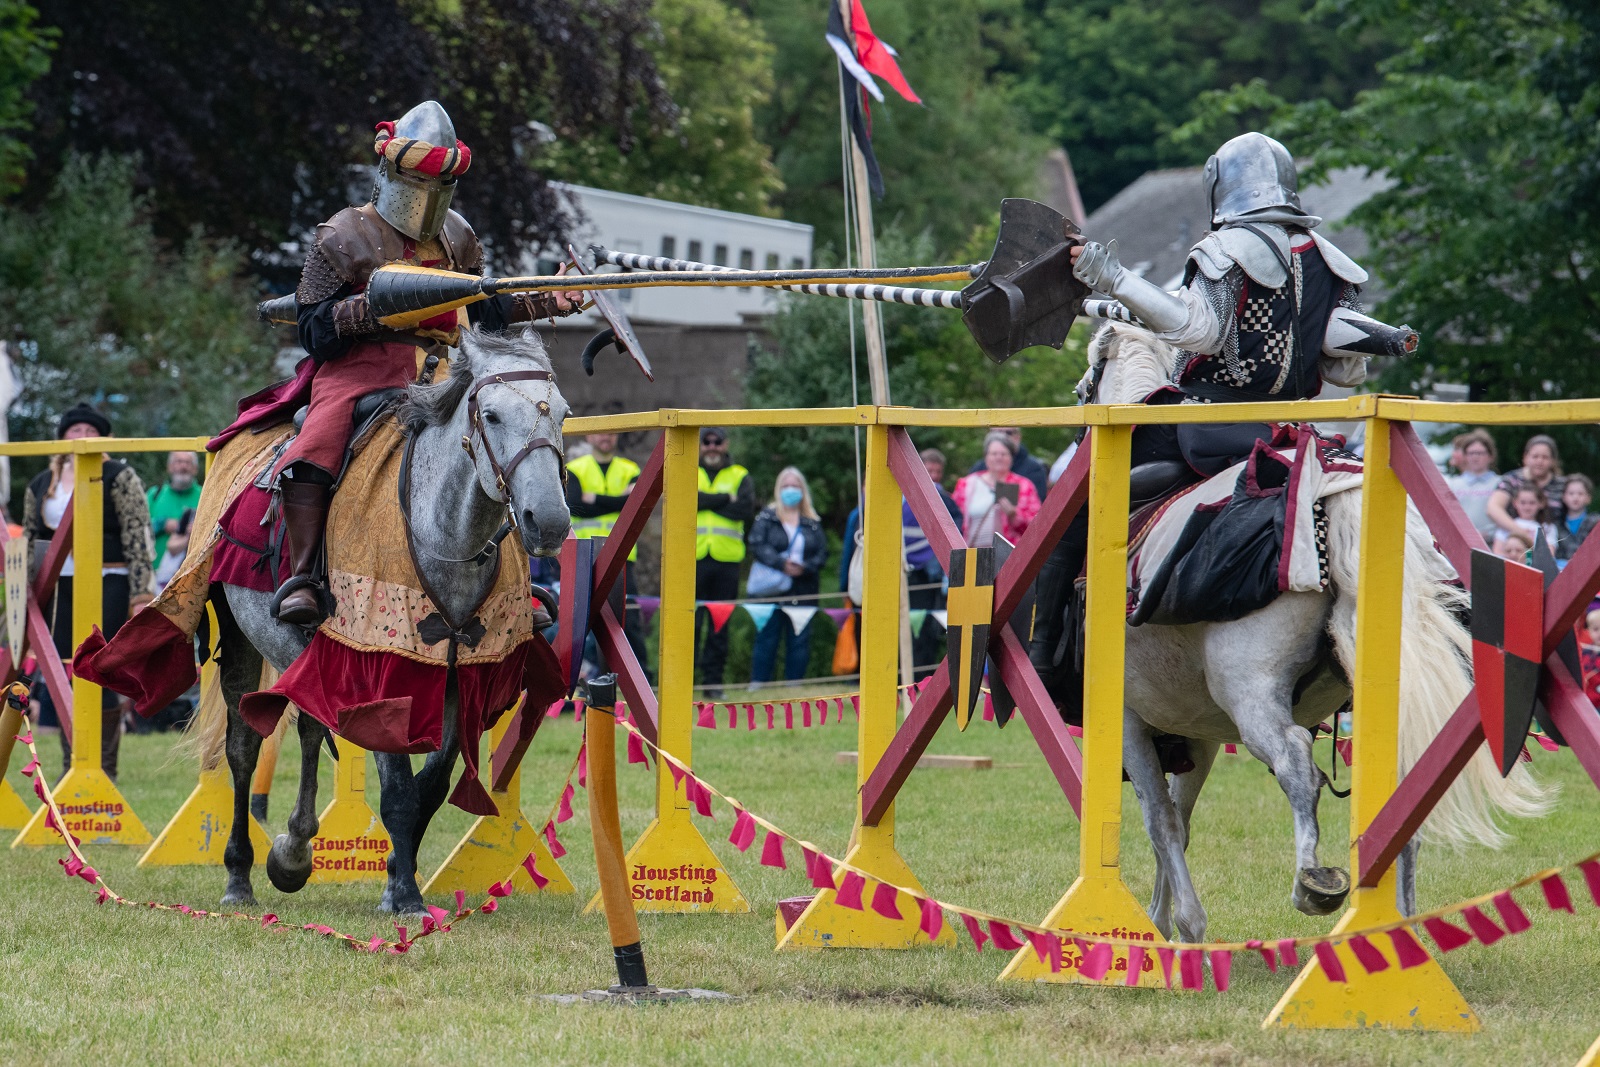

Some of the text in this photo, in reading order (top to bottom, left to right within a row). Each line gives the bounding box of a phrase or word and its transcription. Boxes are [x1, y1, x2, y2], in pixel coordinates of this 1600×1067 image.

[53, 819, 122, 832] cotland
[312, 835, 390, 854] Jousting
[312, 855, 387, 872] Scotland
[631, 863, 718, 885] Jousting
[631, 884, 714, 904] Scotland
